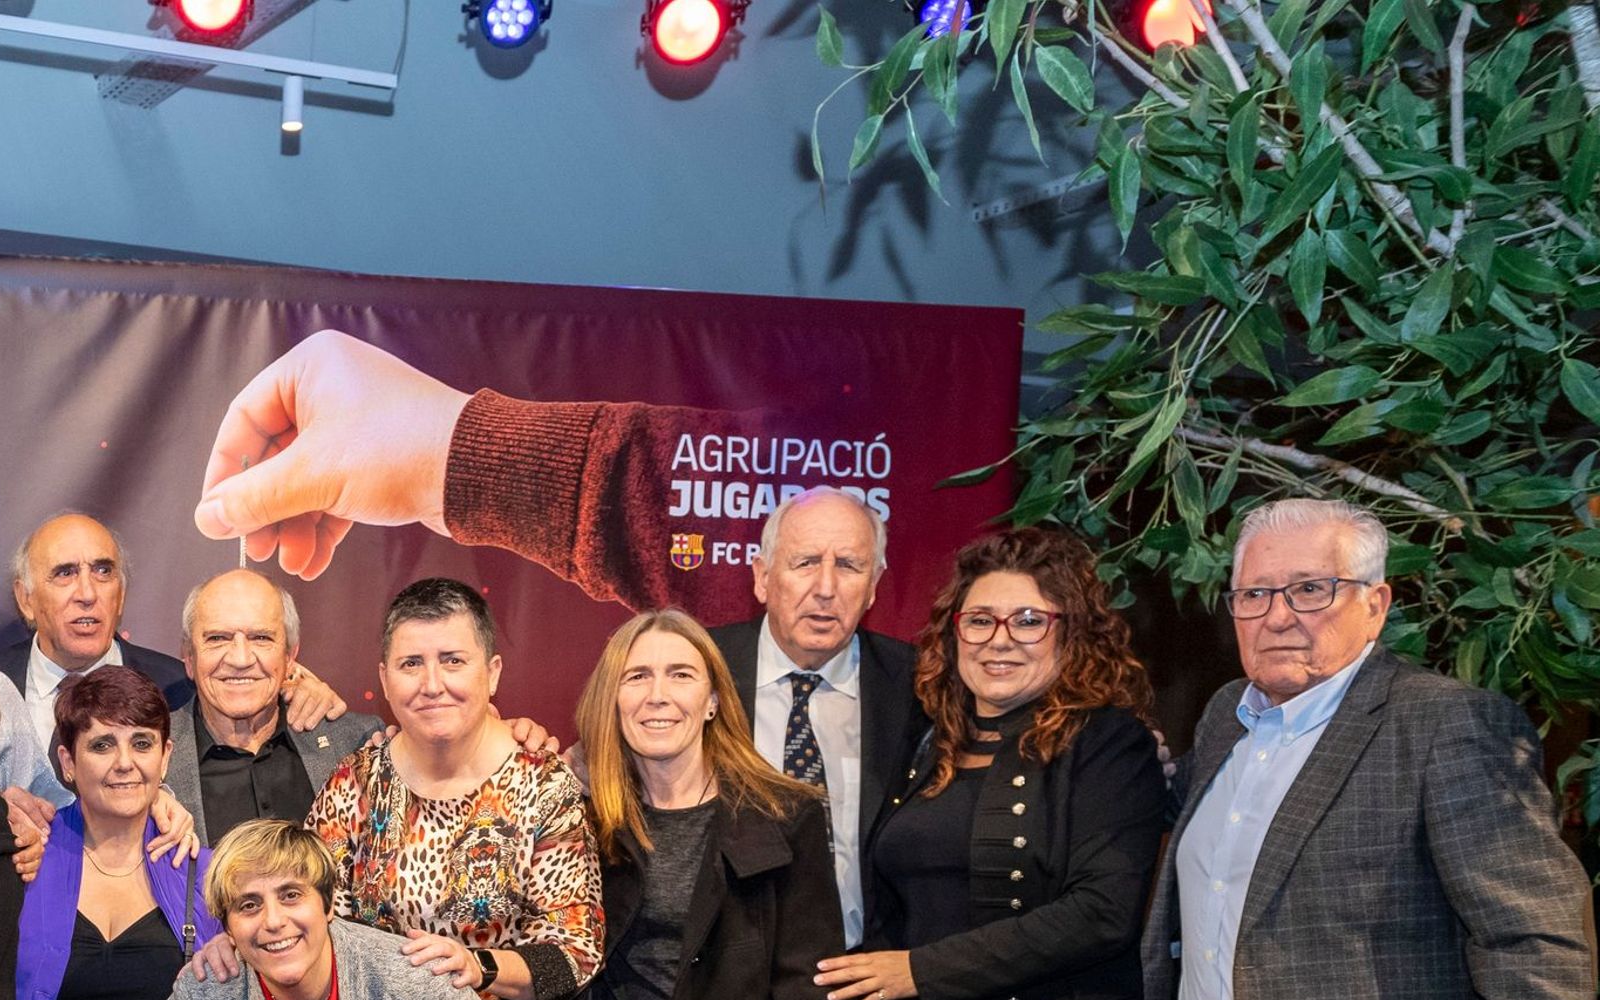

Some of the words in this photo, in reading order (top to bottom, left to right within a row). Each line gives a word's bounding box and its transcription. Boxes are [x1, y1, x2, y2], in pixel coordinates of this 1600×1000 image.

[671, 432, 892, 479] AGRUPACIÓ
[669, 480, 891, 523] JUGAS
[712, 542, 741, 565] FC
